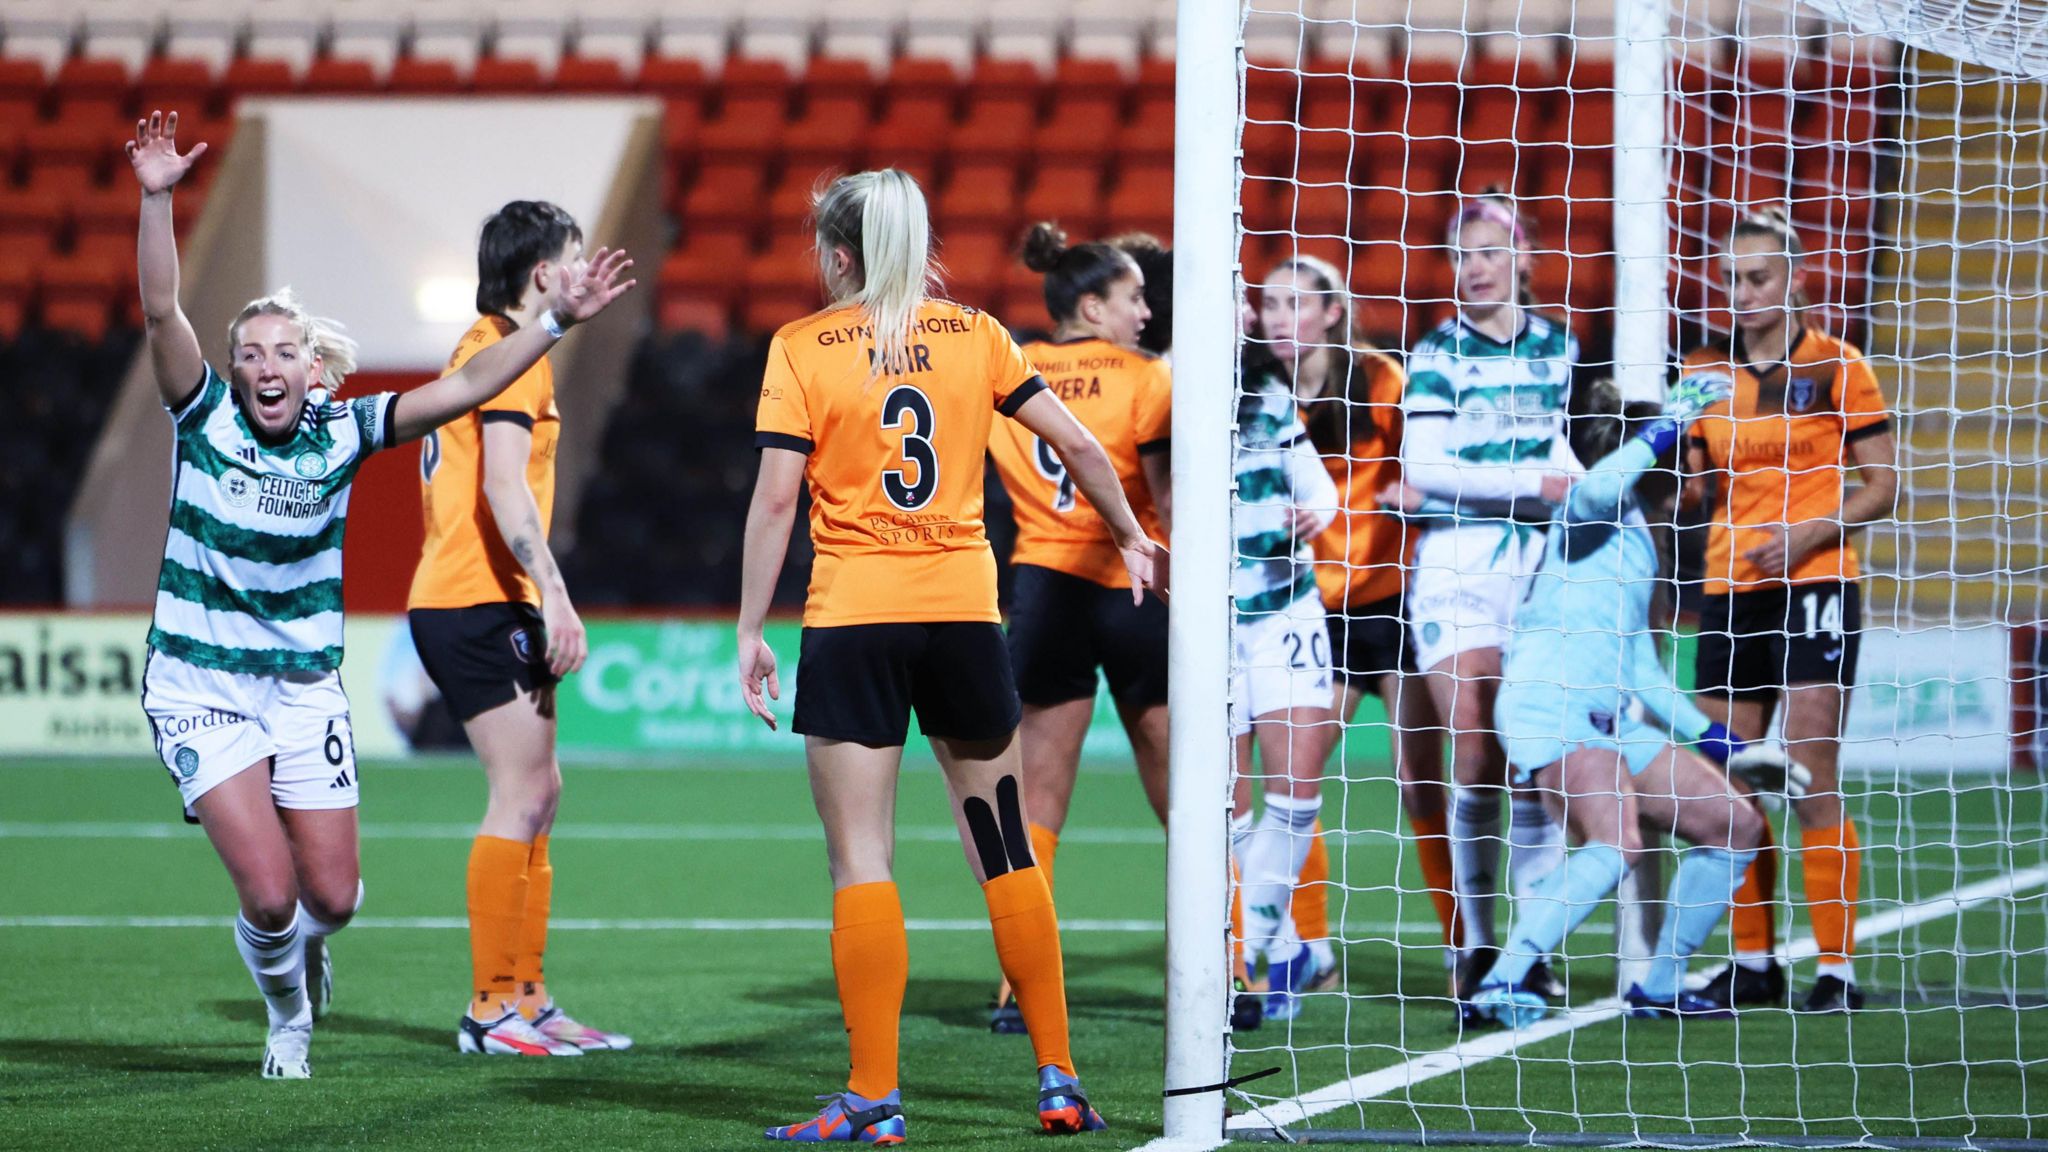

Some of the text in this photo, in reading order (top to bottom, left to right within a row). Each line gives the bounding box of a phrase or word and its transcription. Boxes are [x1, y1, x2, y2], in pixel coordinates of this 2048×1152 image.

[914, 318, 970, 335] HOTEL
[1077, 357, 1126, 370] HOTEL
[881, 384, 939, 511] 3
[260, 475, 321, 502] CELTIC FC
[257, 494, 332, 520] FOUNDATION
[870, 517, 888, 530] PS
[879, 525, 957, 545] SPORTS
[1802, 592, 1842, 640] 14
[1283, 631, 1327, 668] 20
[324, 719, 344, 766] 6
